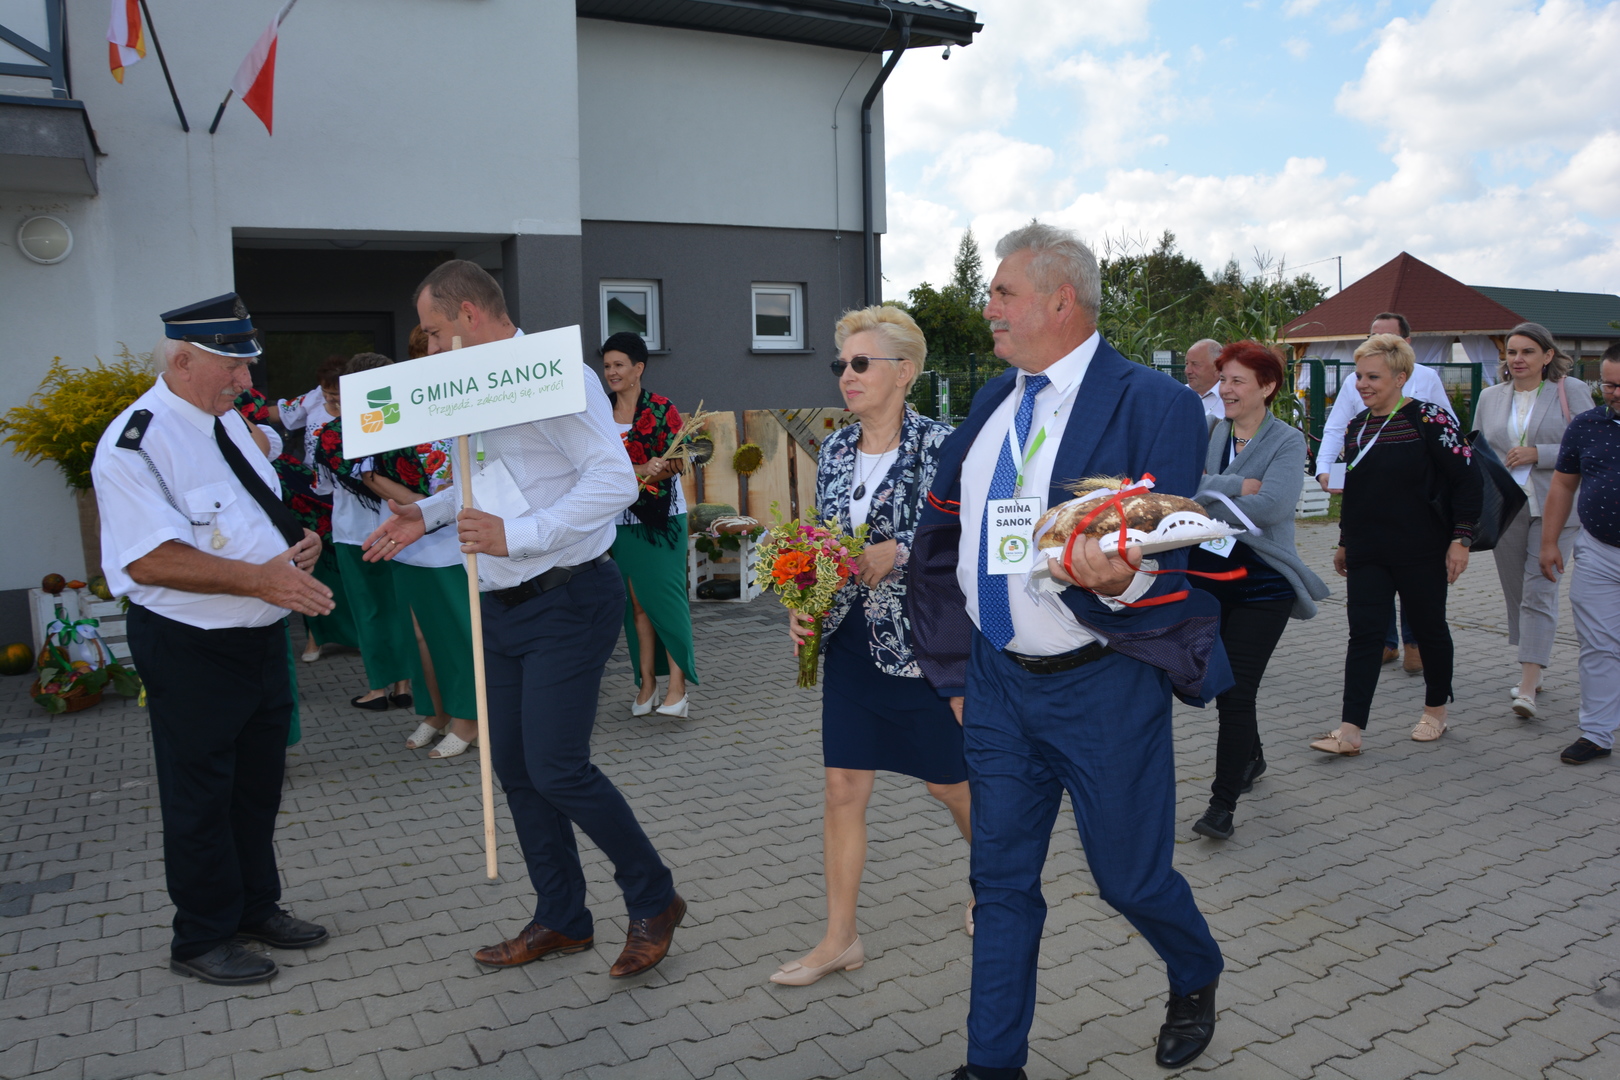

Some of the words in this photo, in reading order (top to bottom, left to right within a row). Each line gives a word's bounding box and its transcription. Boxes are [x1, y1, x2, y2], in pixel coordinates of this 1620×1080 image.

[411, 376, 479, 405] GMINA
[487, 358, 563, 389] SANOK
[428, 398, 474, 417] Przyjedź,
[477, 390, 517, 407] zakochaj
[520, 387, 535, 399] się,
[538, 379, 564, 394] wróć!
[997, 505, 1031, 513] GMINA
[996, 518, 1032, 527] SANOK
